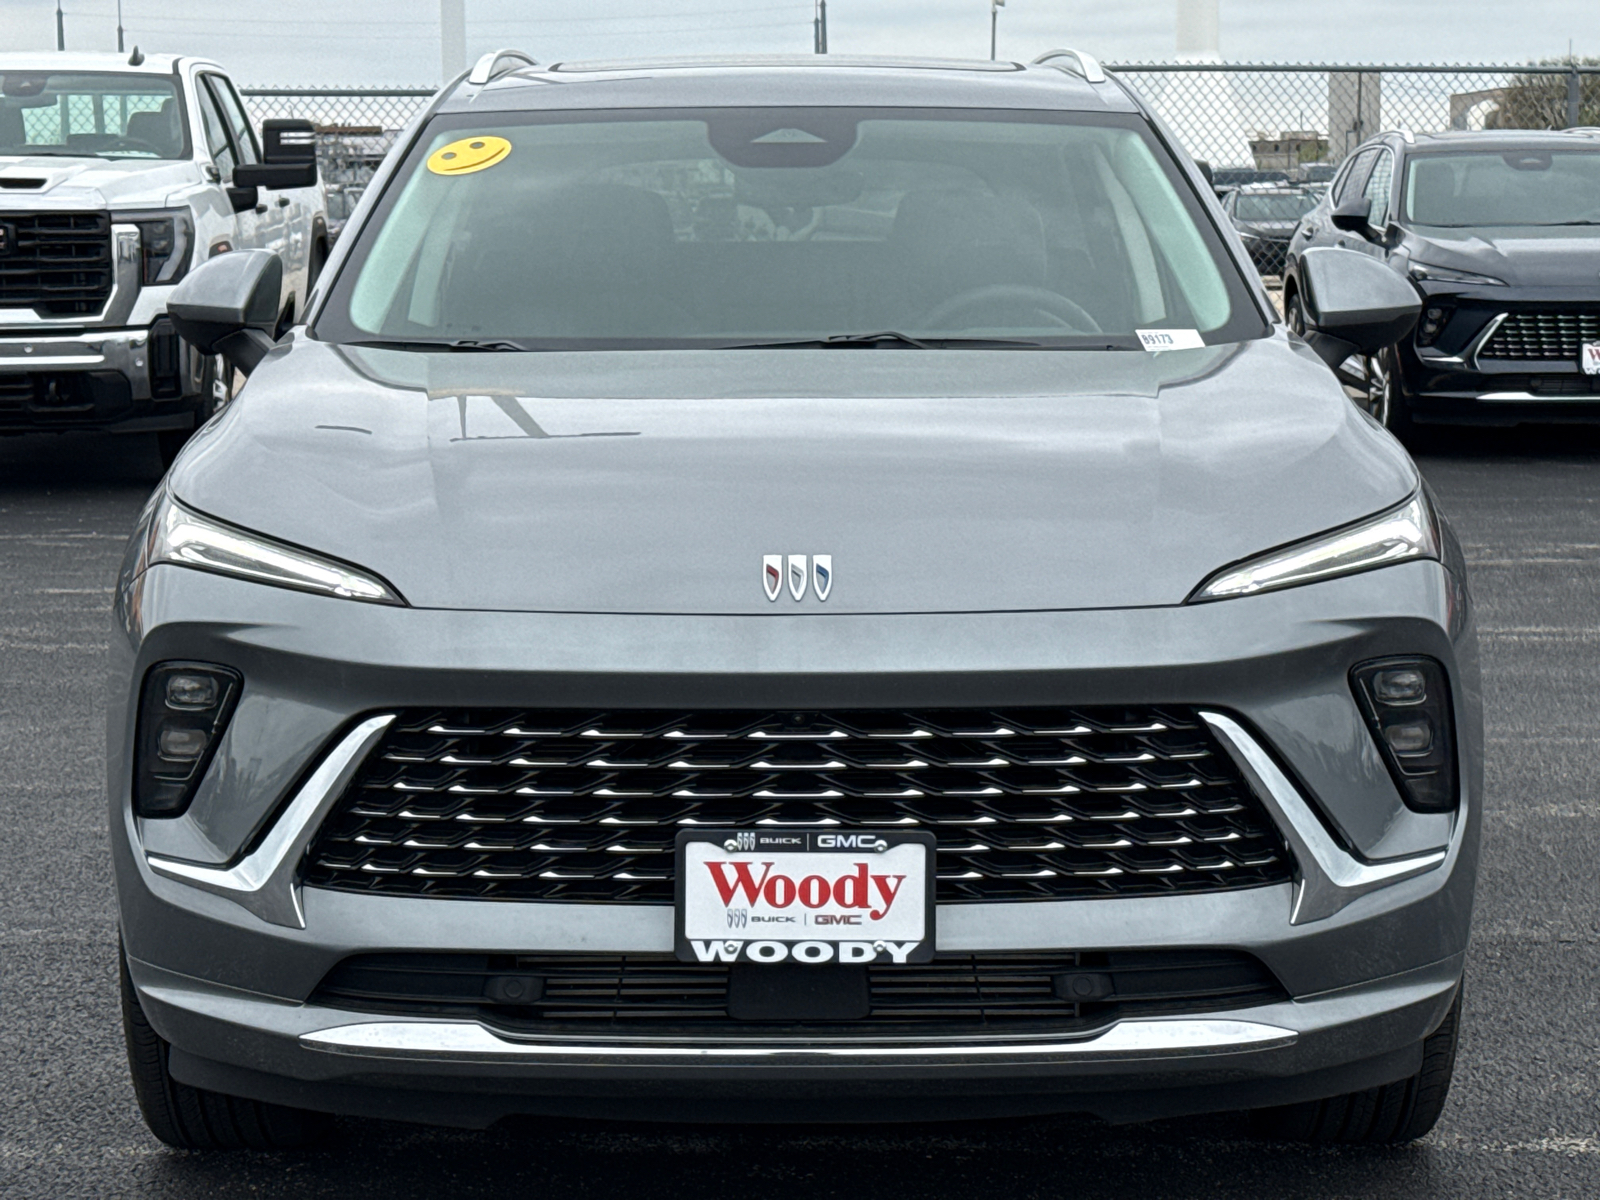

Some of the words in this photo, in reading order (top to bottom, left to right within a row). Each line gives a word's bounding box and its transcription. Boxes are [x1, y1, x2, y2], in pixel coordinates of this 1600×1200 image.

[759, 836, 802, 845] BUICK
[817, 835, 877, 849] GMC
[703, 861, 907, 921] Woody
[751, 915, 796, 923] BUICK
[814, 914, 863, 926] GMC
[690, 940, 921, 964] WOODY
